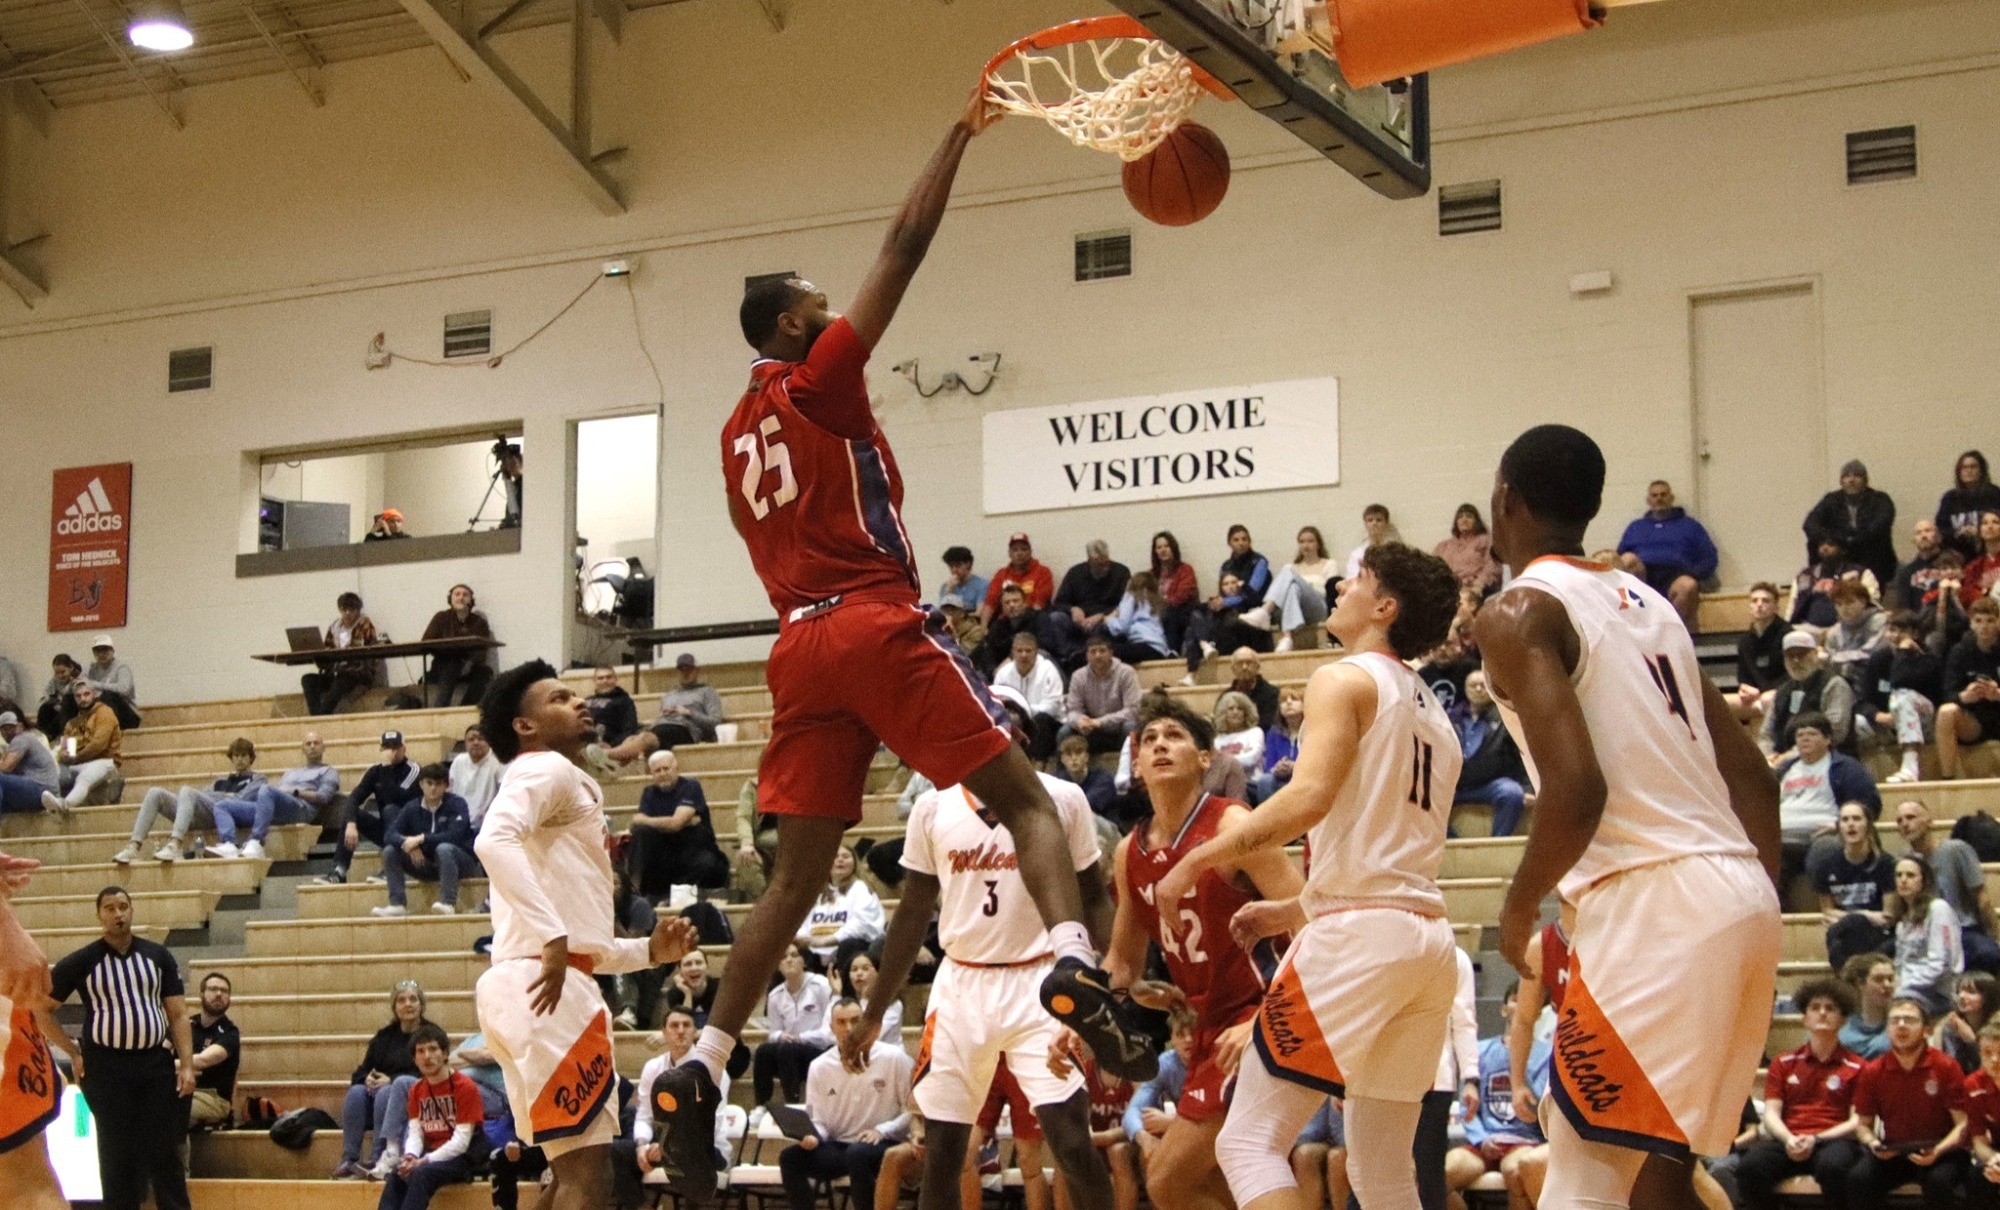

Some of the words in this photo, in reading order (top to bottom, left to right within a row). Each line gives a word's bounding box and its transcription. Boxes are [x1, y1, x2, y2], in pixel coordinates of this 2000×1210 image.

[1048, 396, 1265, 446] WELCOME
[733, 414, 799, 521] 25
[1063, 446, 1254, 493] VISITORS
[57, 511, 122, 535] adidas
[1408, 731, 1432, 811] 11
[948, 843, 1018, 874] Wildca
[983, 880, 998, 917] 3
[1159, 909, 1208, 964] 42
[554, 1053, 608, 1117] Baker
[1557, 1008, 1623, 1113] Wildcats
